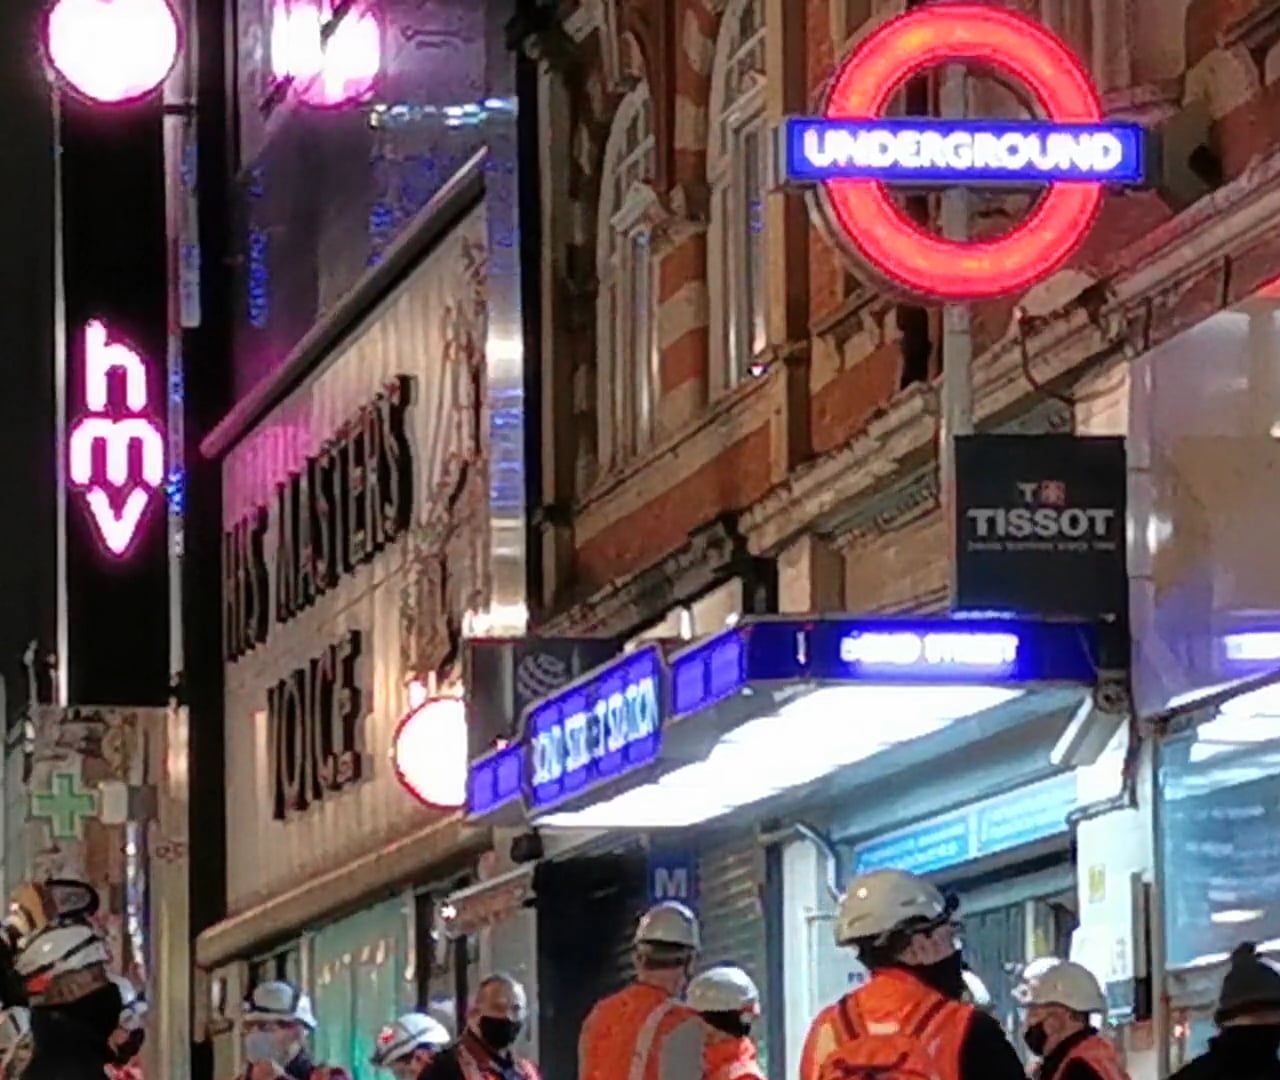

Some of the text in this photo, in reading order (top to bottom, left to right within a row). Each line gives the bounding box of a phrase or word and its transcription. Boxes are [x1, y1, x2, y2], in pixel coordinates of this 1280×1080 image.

[803, 128, 1122, 171] UNDERGROUND
[69, 318, 165, 556] hmv
[966, 507, 1115, 538] TISSOT
[266, 630, 363, 820] VOICE
[654, 867, 688, 899] M
